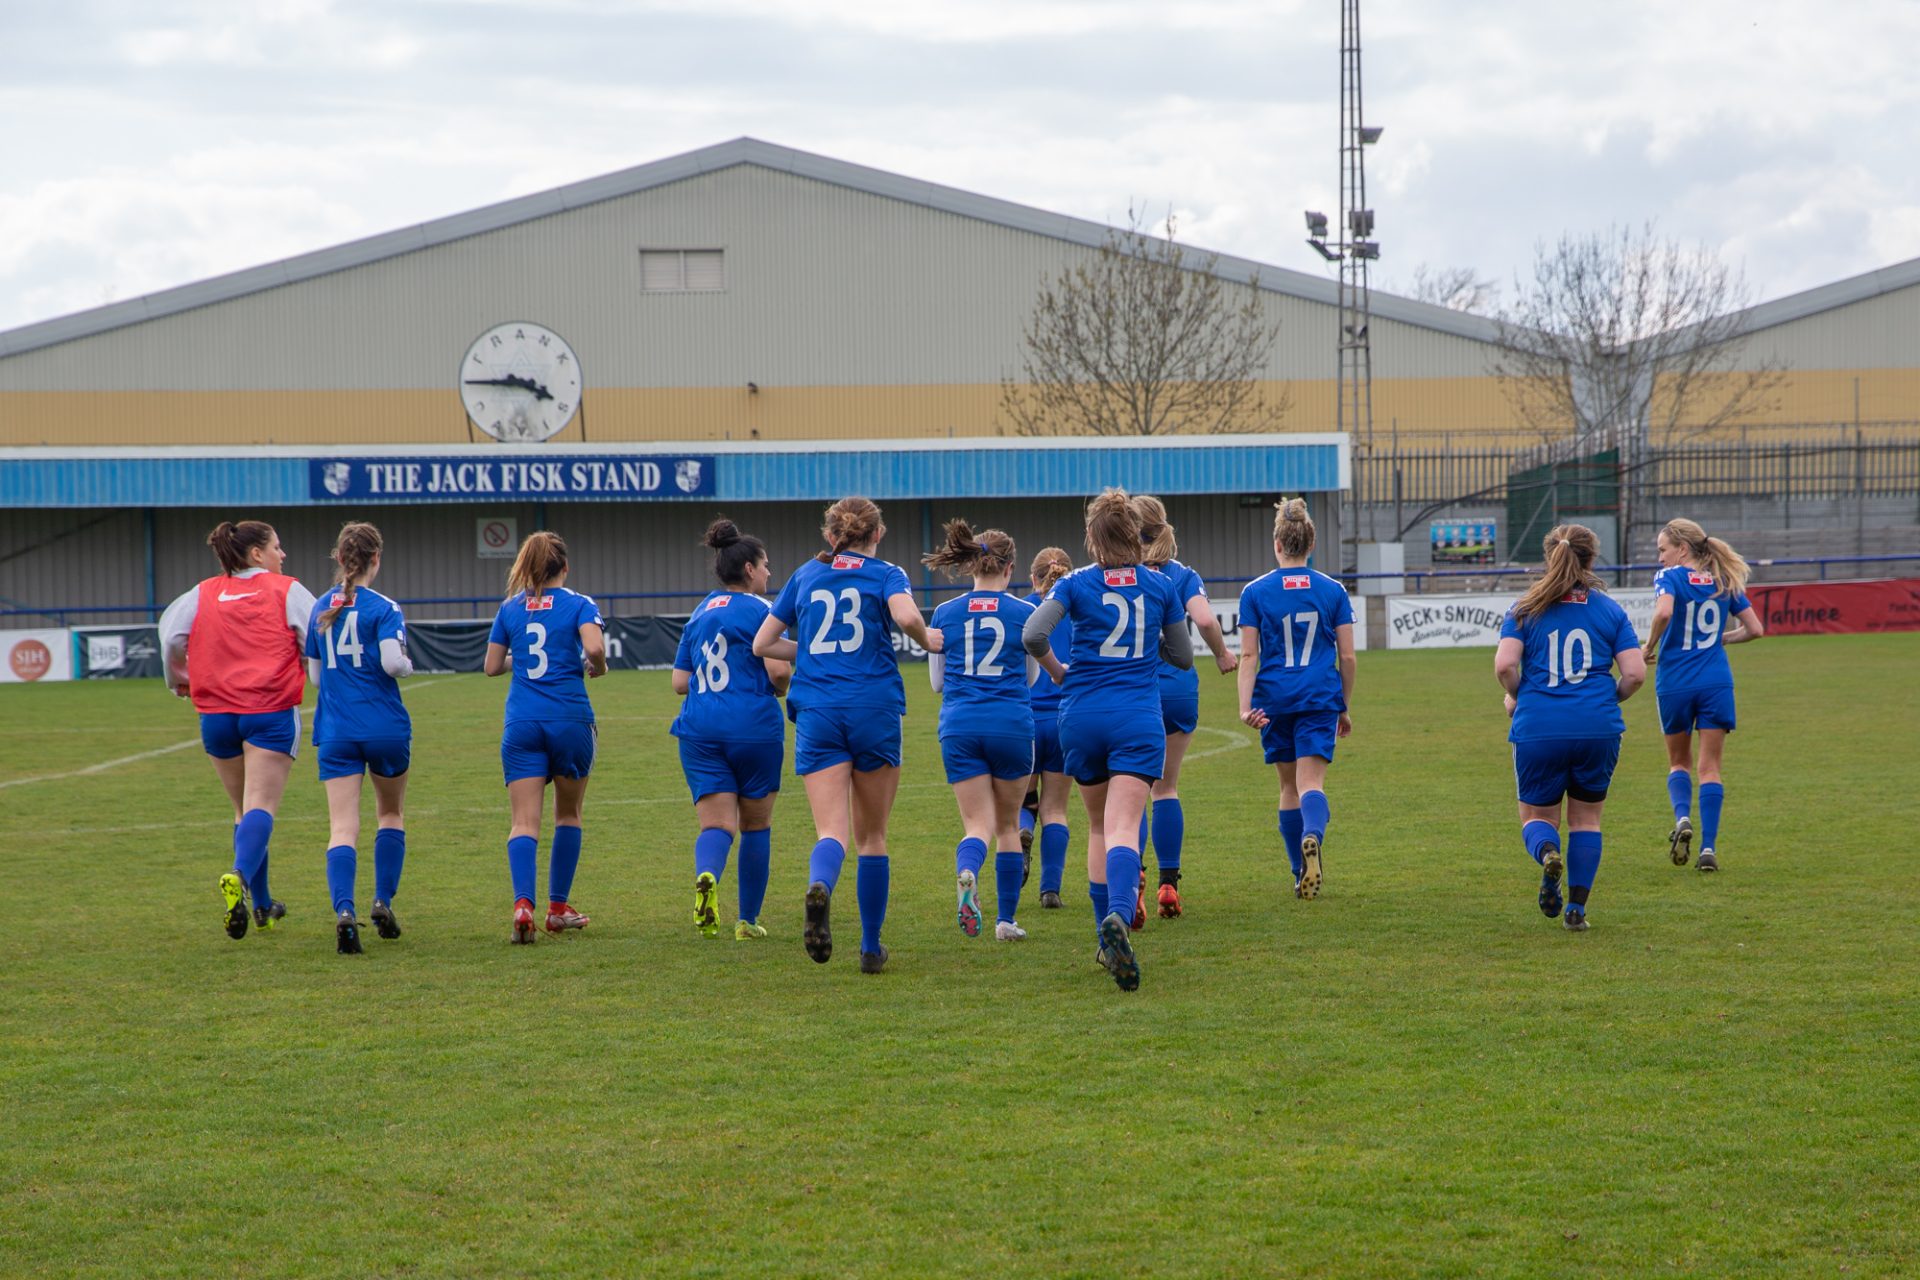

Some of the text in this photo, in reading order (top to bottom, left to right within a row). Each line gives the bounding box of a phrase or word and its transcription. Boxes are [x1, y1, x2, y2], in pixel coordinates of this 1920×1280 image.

[366, 462, 661, 493] THE JACK FISK STAND
[1107, 570, 1133, 579] PITCHING
[809, 588, 864, 655] 23
[1100, 593, 1145, 658] 21
[1393, 607, 1434, 635] PECK
[1444, 605, 1505, 632] SNYDER
[1682, 600, 1721, 651] 19
[1754, 588, 1839, 631] Tahinee
[324, 611, 364, 669] 14
[526, 623, 549, 680] 3
[697, 633, 730, 694] 18
[964, 617, 1005, 676] 12
[1282, 611, 1319, 668] 17
[1547, 628, 1592, 687] 10
